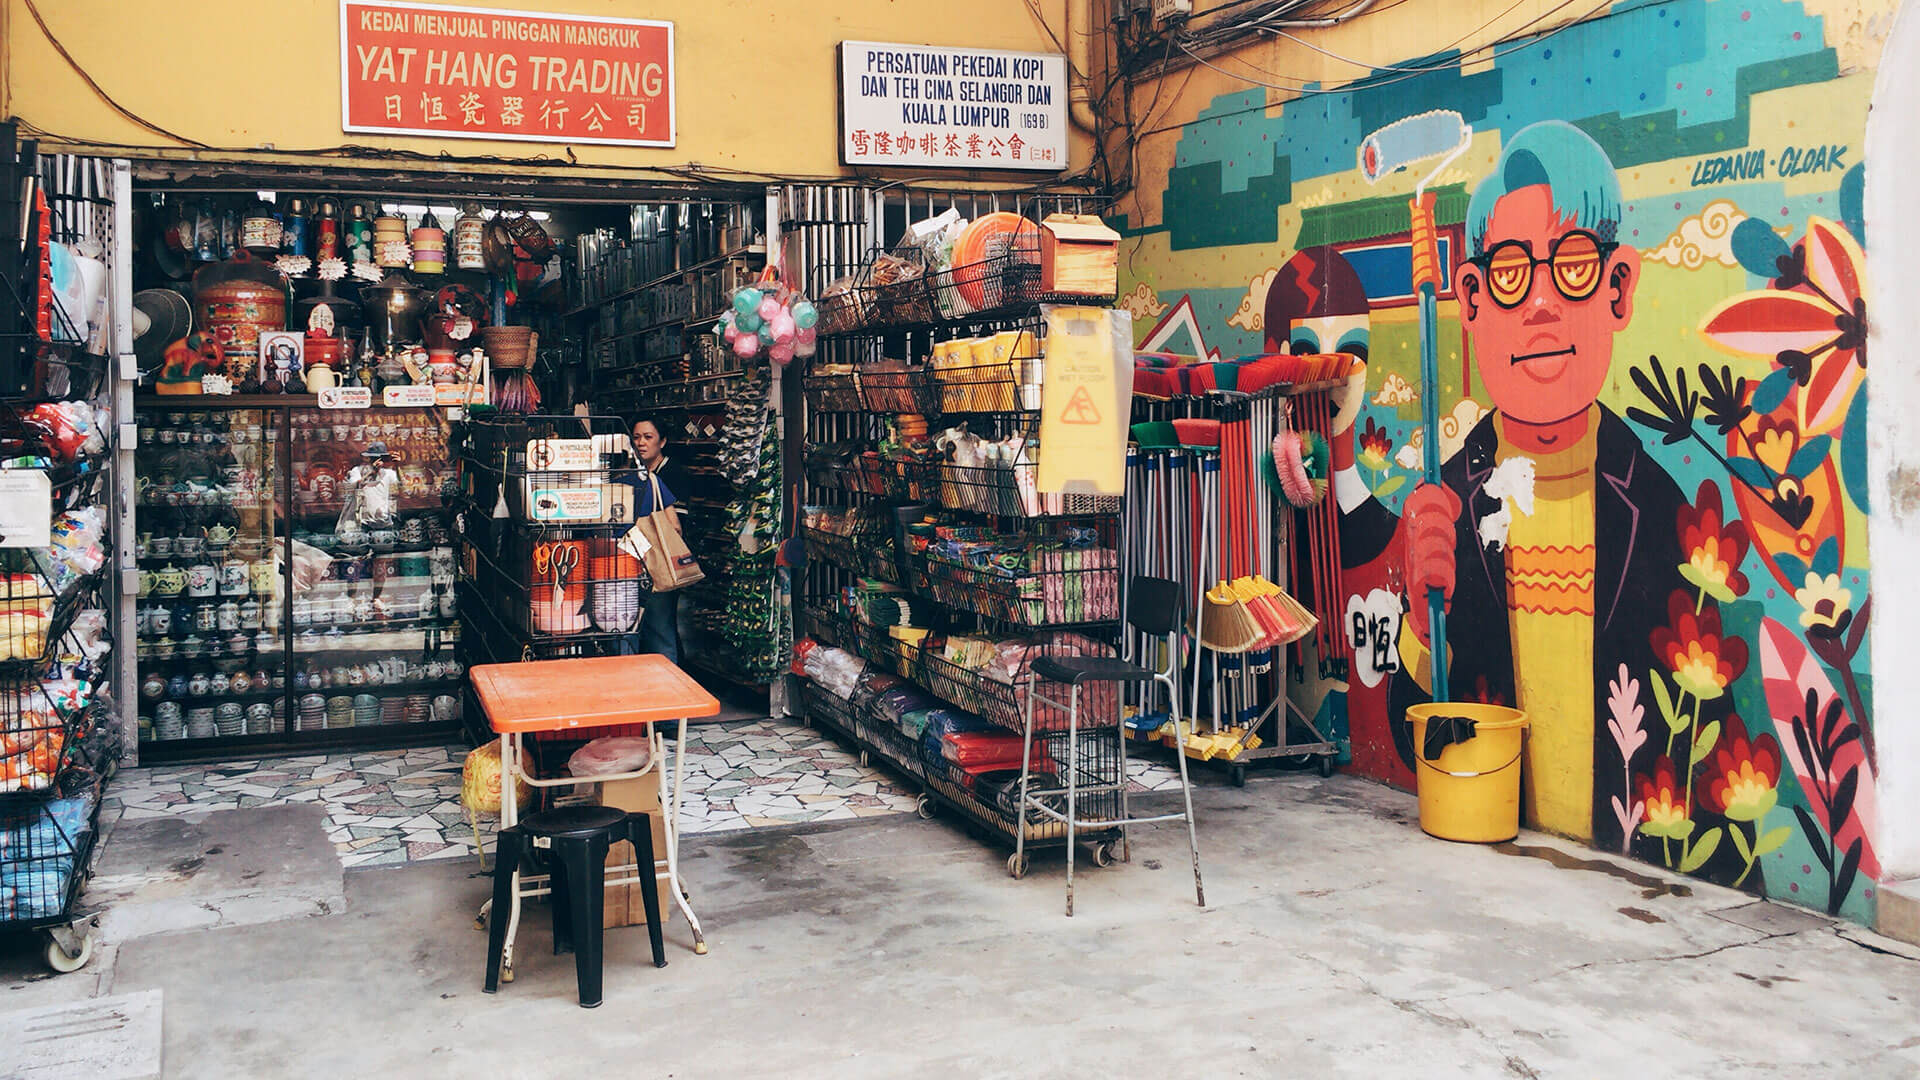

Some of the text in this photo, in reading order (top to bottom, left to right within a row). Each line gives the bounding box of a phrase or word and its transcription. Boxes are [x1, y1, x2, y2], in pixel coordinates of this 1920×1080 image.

[360, 10, 641, 49] KEDAI MENJUAL PINGGAN MANGKUK
[356, 45, 664, 97] YAT HANG TRADING
[867, 51, 1043, 81] PERSATUAN PEKEDAI KOPI
[862, 75, 1052, 106] DAN TEH CINA SELANGOR DAN
[384, 91, 646, 134] 日恒瓷器行公司
[903, 102, 947, 126] KUALA
[953, 105, 1010, 129] LUMPUR
[851, 129, 1026, 161] 雪隆咖啡茶業公會
[1691, 145, 1848, 187] LEDANIA CLOAK
